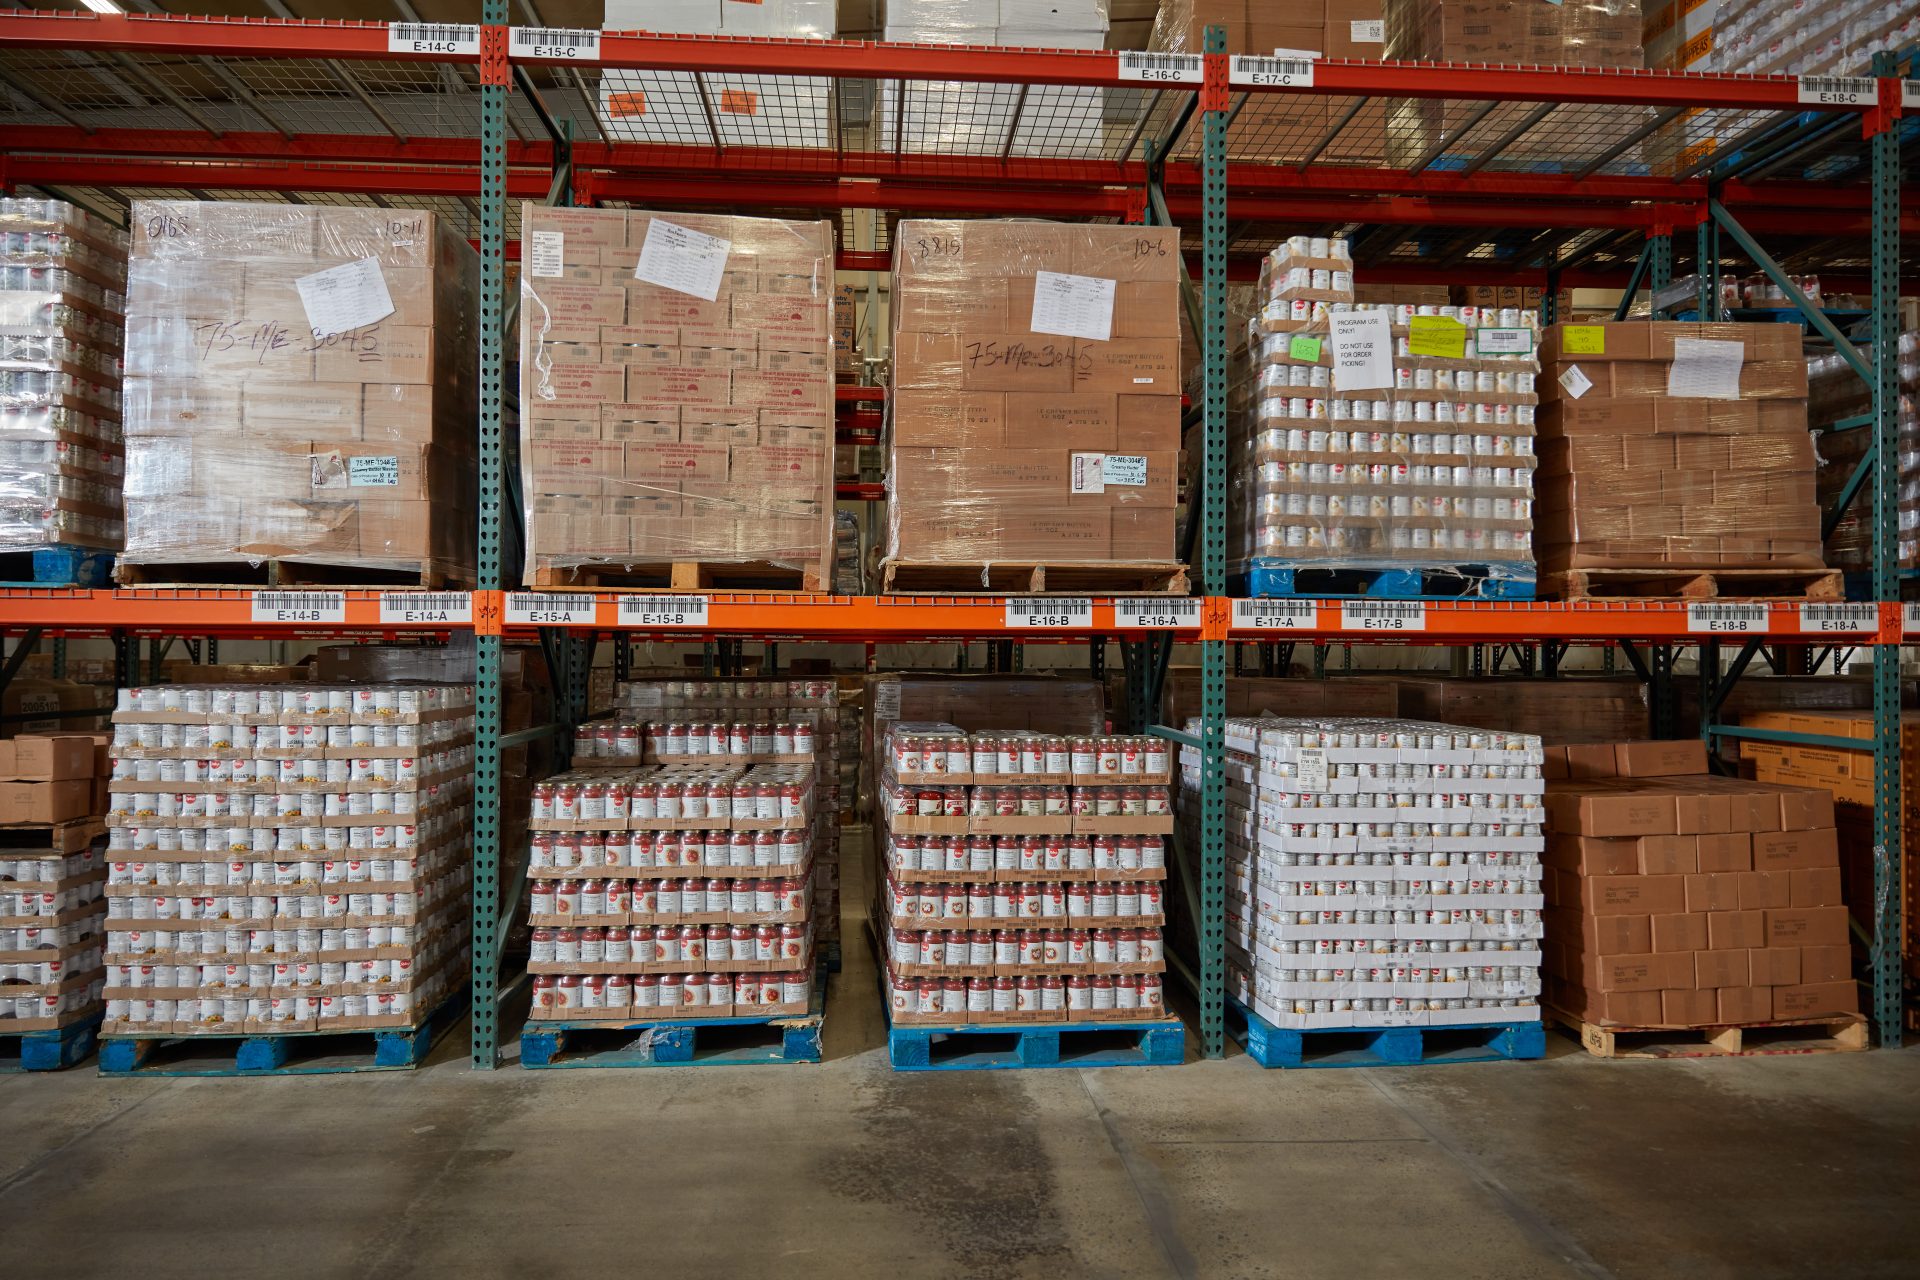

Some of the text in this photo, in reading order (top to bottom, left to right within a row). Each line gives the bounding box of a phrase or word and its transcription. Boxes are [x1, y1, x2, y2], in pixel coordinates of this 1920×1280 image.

[413, 41, 456, 53] E-14-C
[534, 46, 576, 58] E-15-C
[1142, 69, 1181, 81] E-16-C
[1252, 73, 1291, 85] E-17-C
[1820, 92, 1857, 103] E-18-C
[385, 219, 422, 237] 10-11
[1134, 238, 1166, 259] 10-6
[278, 611, 321, 621] E-14-B
[405, 611, 448, 621] E-14-A
[530, 612, 572, 622] E-15-A
[642, 614, 684, 624] E-15-B
[1029, 616, 1069, 626] E-16-B
[1138, 616, 1178, 626] E-16-A
[1255, 617, 1294, 627] E-17-A
[1364, 619, 1403, 629] E-17-B
[1709, 621, 1748, 630] E-18-B
[1821, 621, 1858, 630] E-18-A
